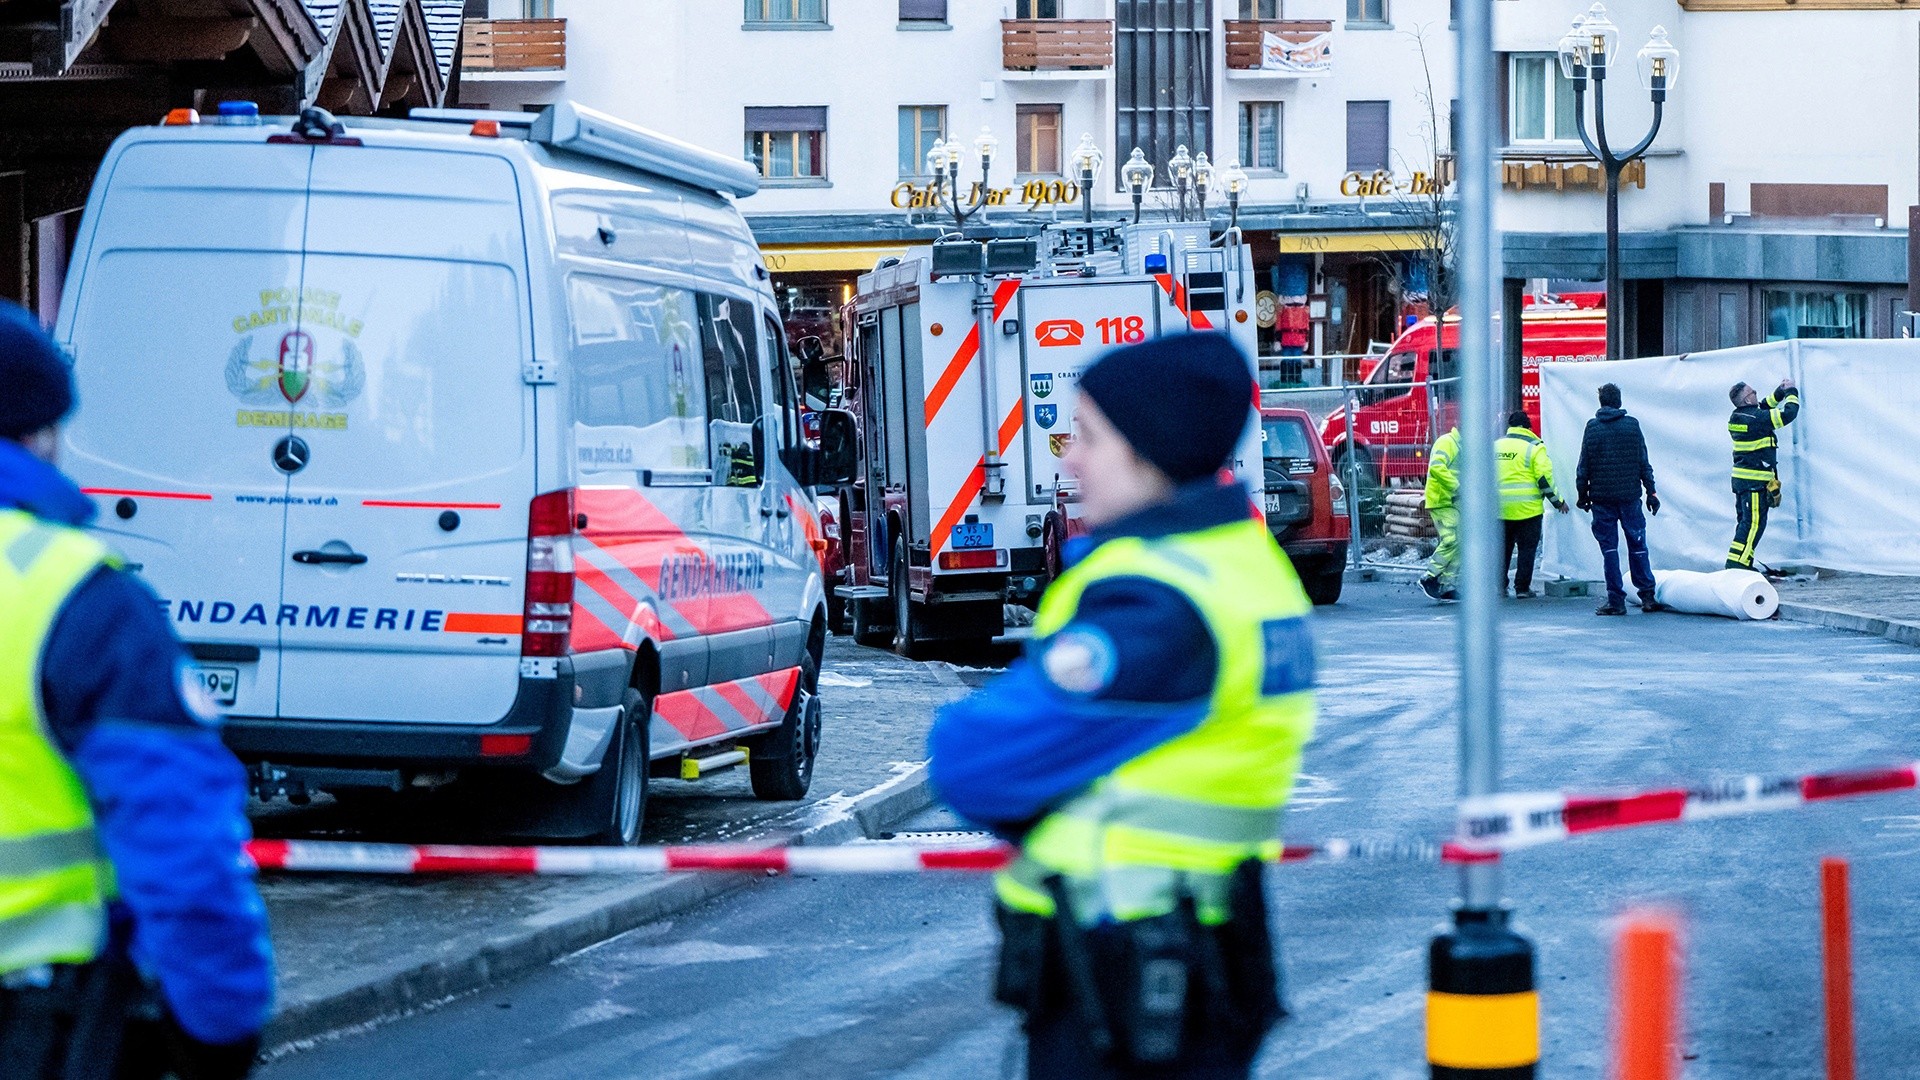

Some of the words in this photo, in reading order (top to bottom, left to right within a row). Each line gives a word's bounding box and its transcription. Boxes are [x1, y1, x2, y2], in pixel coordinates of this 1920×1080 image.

[1018, 179, 1079, 212] 1900
[1299, 236, 1329, 251] 1900
[232, 305, 364, 338] CANTONALE
[1096, 315, 1146, 344] 118
[963, 535, 982, 547] 252
[658, 551, 765, 601] GENDARMERIE
